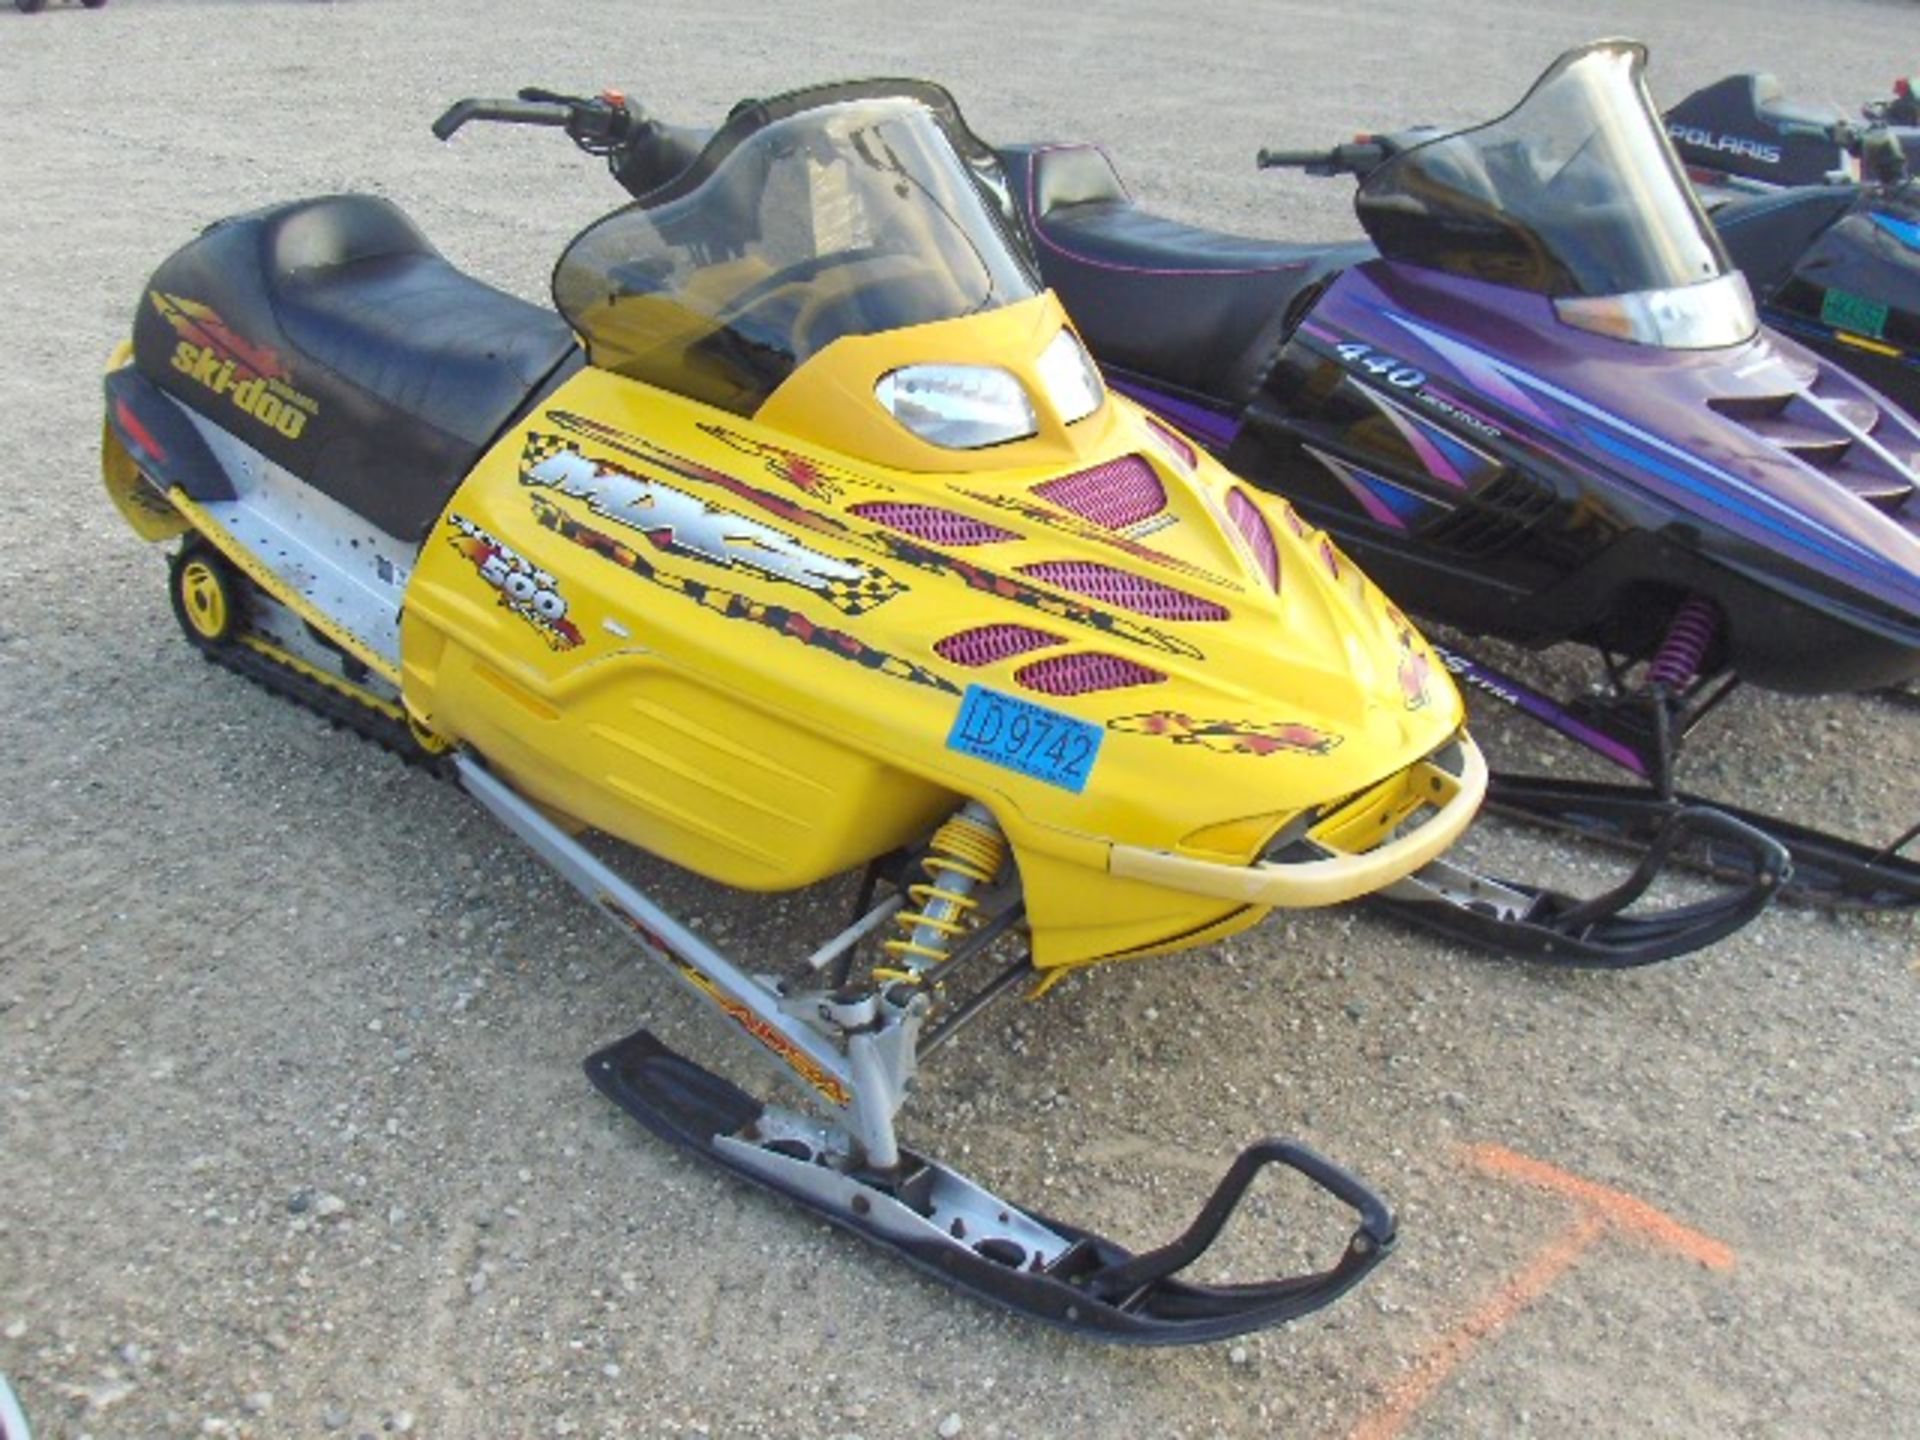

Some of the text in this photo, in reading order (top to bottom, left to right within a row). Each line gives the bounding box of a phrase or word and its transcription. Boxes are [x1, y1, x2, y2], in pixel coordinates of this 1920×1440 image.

[1669, 123, 1782, 163] POLARIS
[1337, 343, 1427, 388] 440
[481, 553, 567, 620] 500
[1004, 714, 1093, 778] 9742
